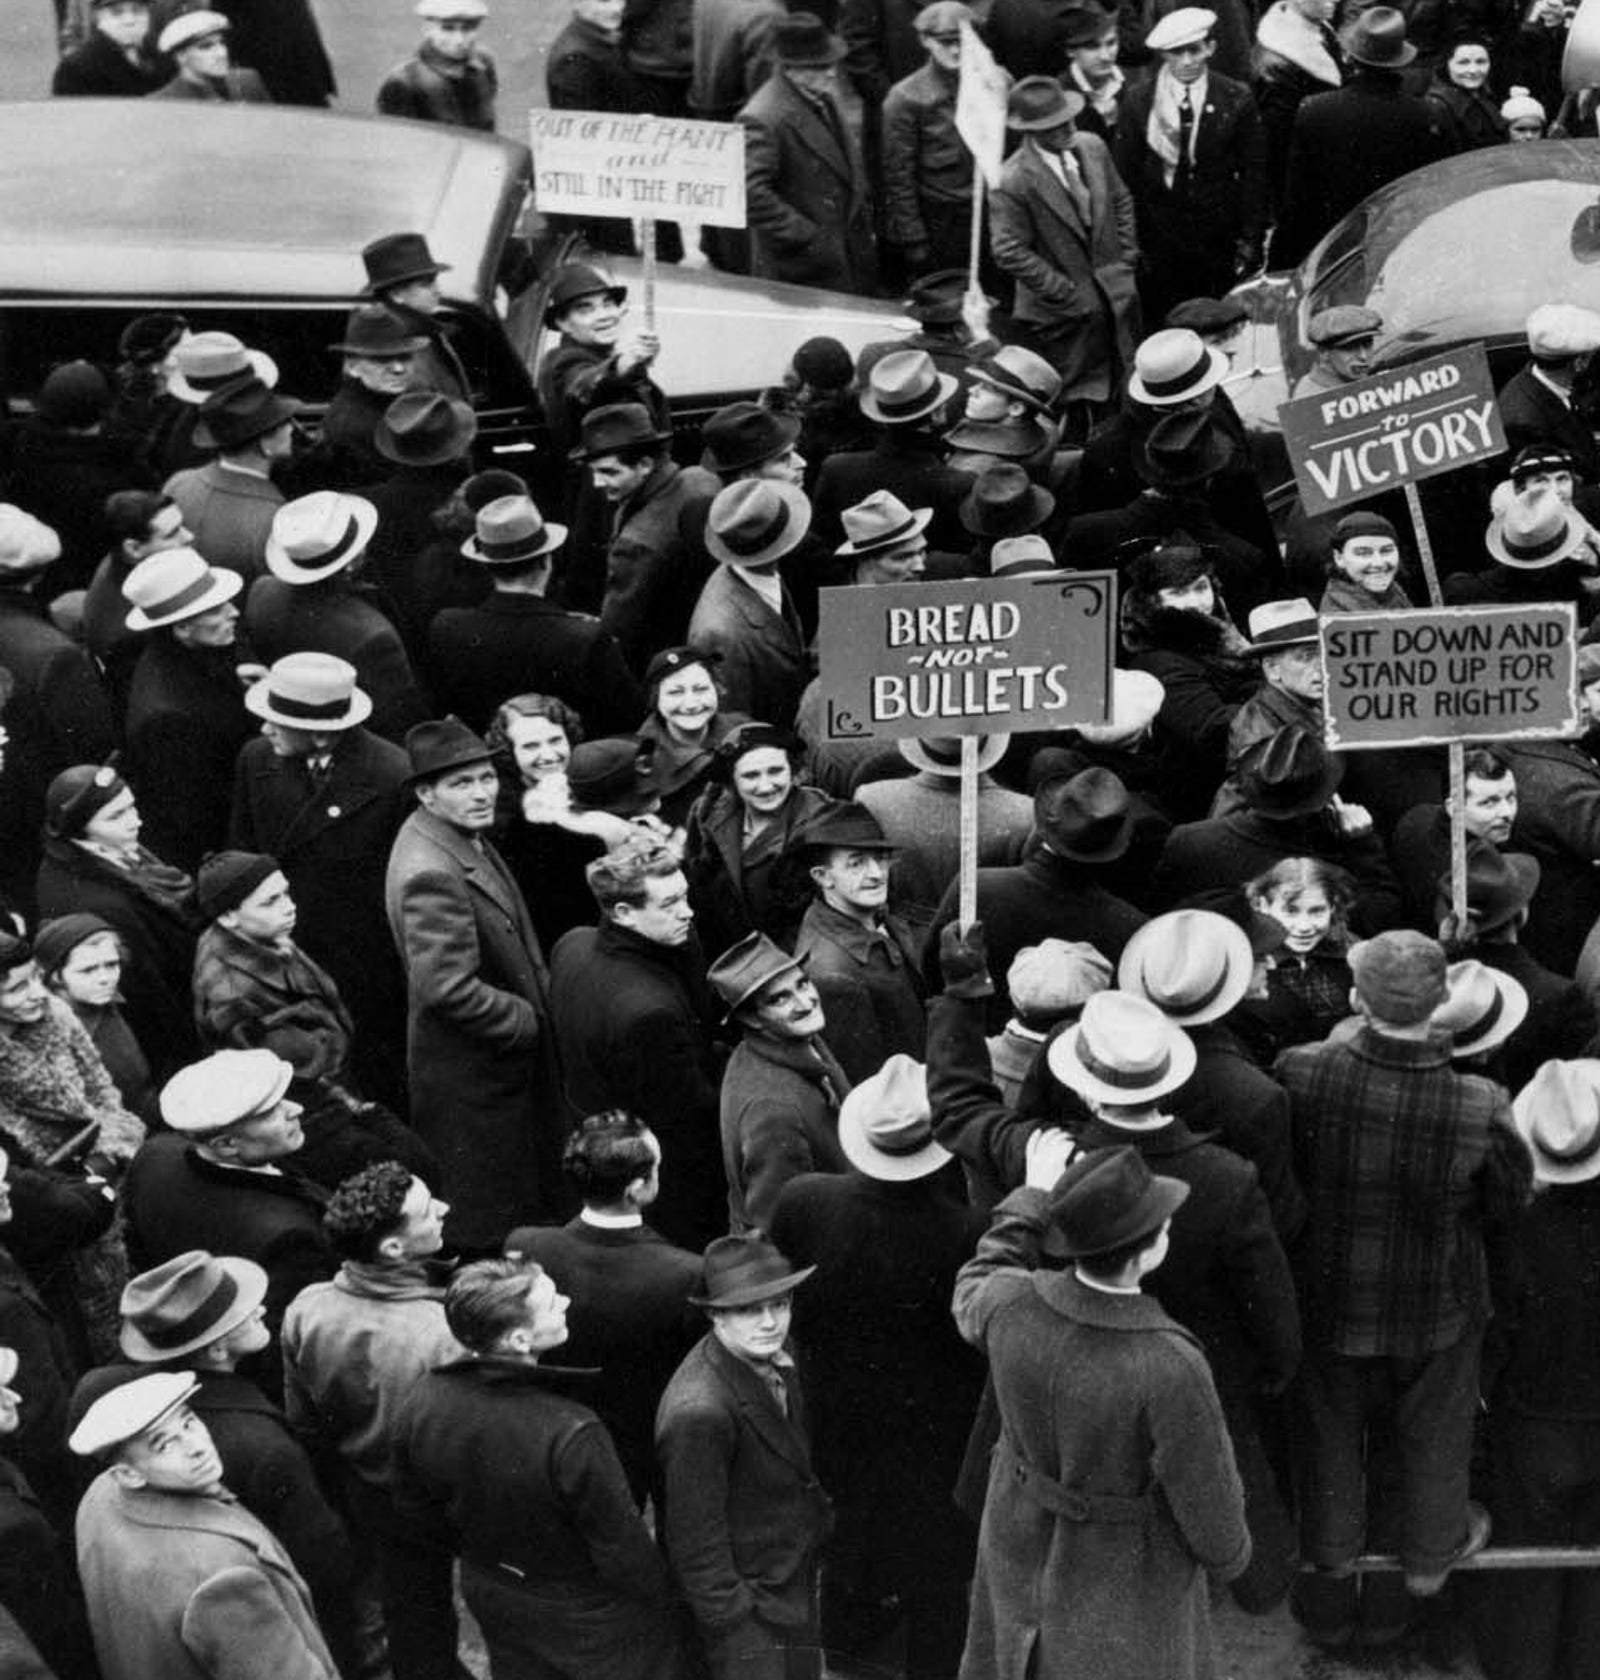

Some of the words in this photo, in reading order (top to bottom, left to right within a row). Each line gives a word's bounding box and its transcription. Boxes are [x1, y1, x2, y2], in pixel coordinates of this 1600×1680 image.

[536, 115, 574, 138] OUT
[581, 118, 603, 140] OF
[608, 120, 650, 143] THE
[539, 171, 592, 197] STILL
[597, 175, 623, 198] IN
[626, 178, 667, 203] THE
[675, 181, 729, 208] FIGHT
[1320, 364, 1460, 426] FORWARD
[1381, 413, 1409, 432] to
[1304, 401, 1494, 499] VICTORY
[888, 601, 1021, 648] BREAD
[1327, 630, 1380, 658] SIT
[1393, 624, 1492, 655] DOWN
[1498, 622, 1564, 649] AND
[1339, 659, 1437, 688] STAND
[1449, 657, 1487, 685] UP
[1500, 653, 1555, 682] FOR
[871, 664, 1068, 722] BULLETS
[1348, 692, 1418, 720] OUR
[1435, 686, 1540, 717] RIGHTS
